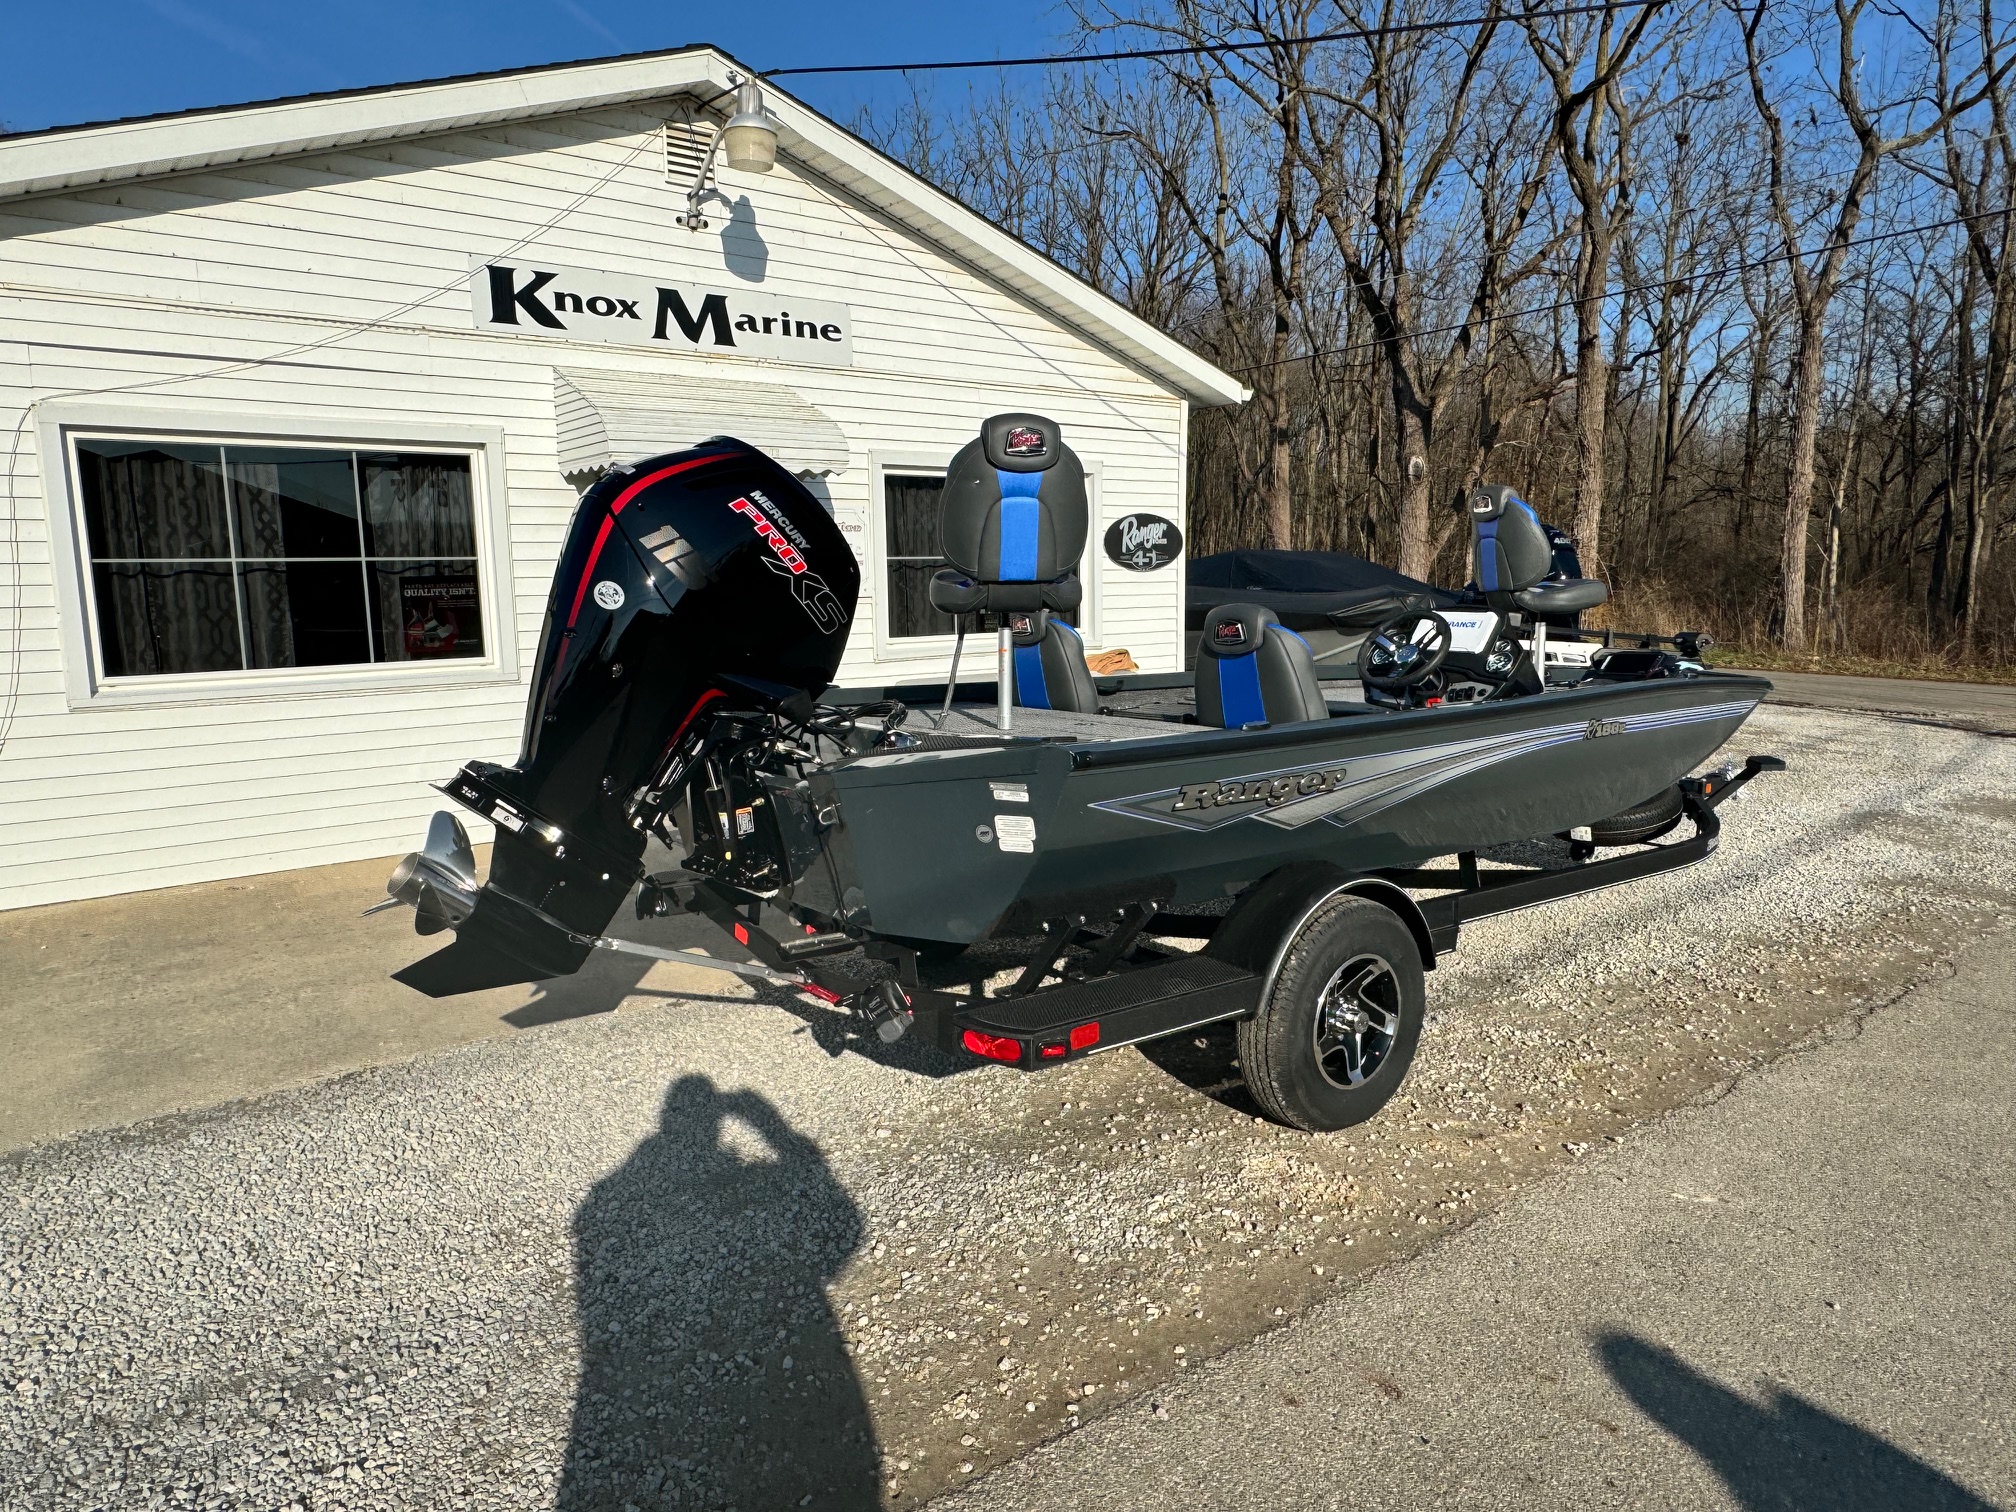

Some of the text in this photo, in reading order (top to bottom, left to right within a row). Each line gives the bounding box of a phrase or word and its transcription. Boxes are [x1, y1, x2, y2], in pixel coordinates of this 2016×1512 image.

[486, 264, 843, 348] Knox Marine
[728, 497, 807, 574] PRO
[750, 490, 811, 549] MERCURY
[1119, 516, 1168, 554] Ranger
[404, 589, 448, 597] QUALITY
[760, 543, 848, 634] XS
[1171, 769, 1347, 813] Ranger
